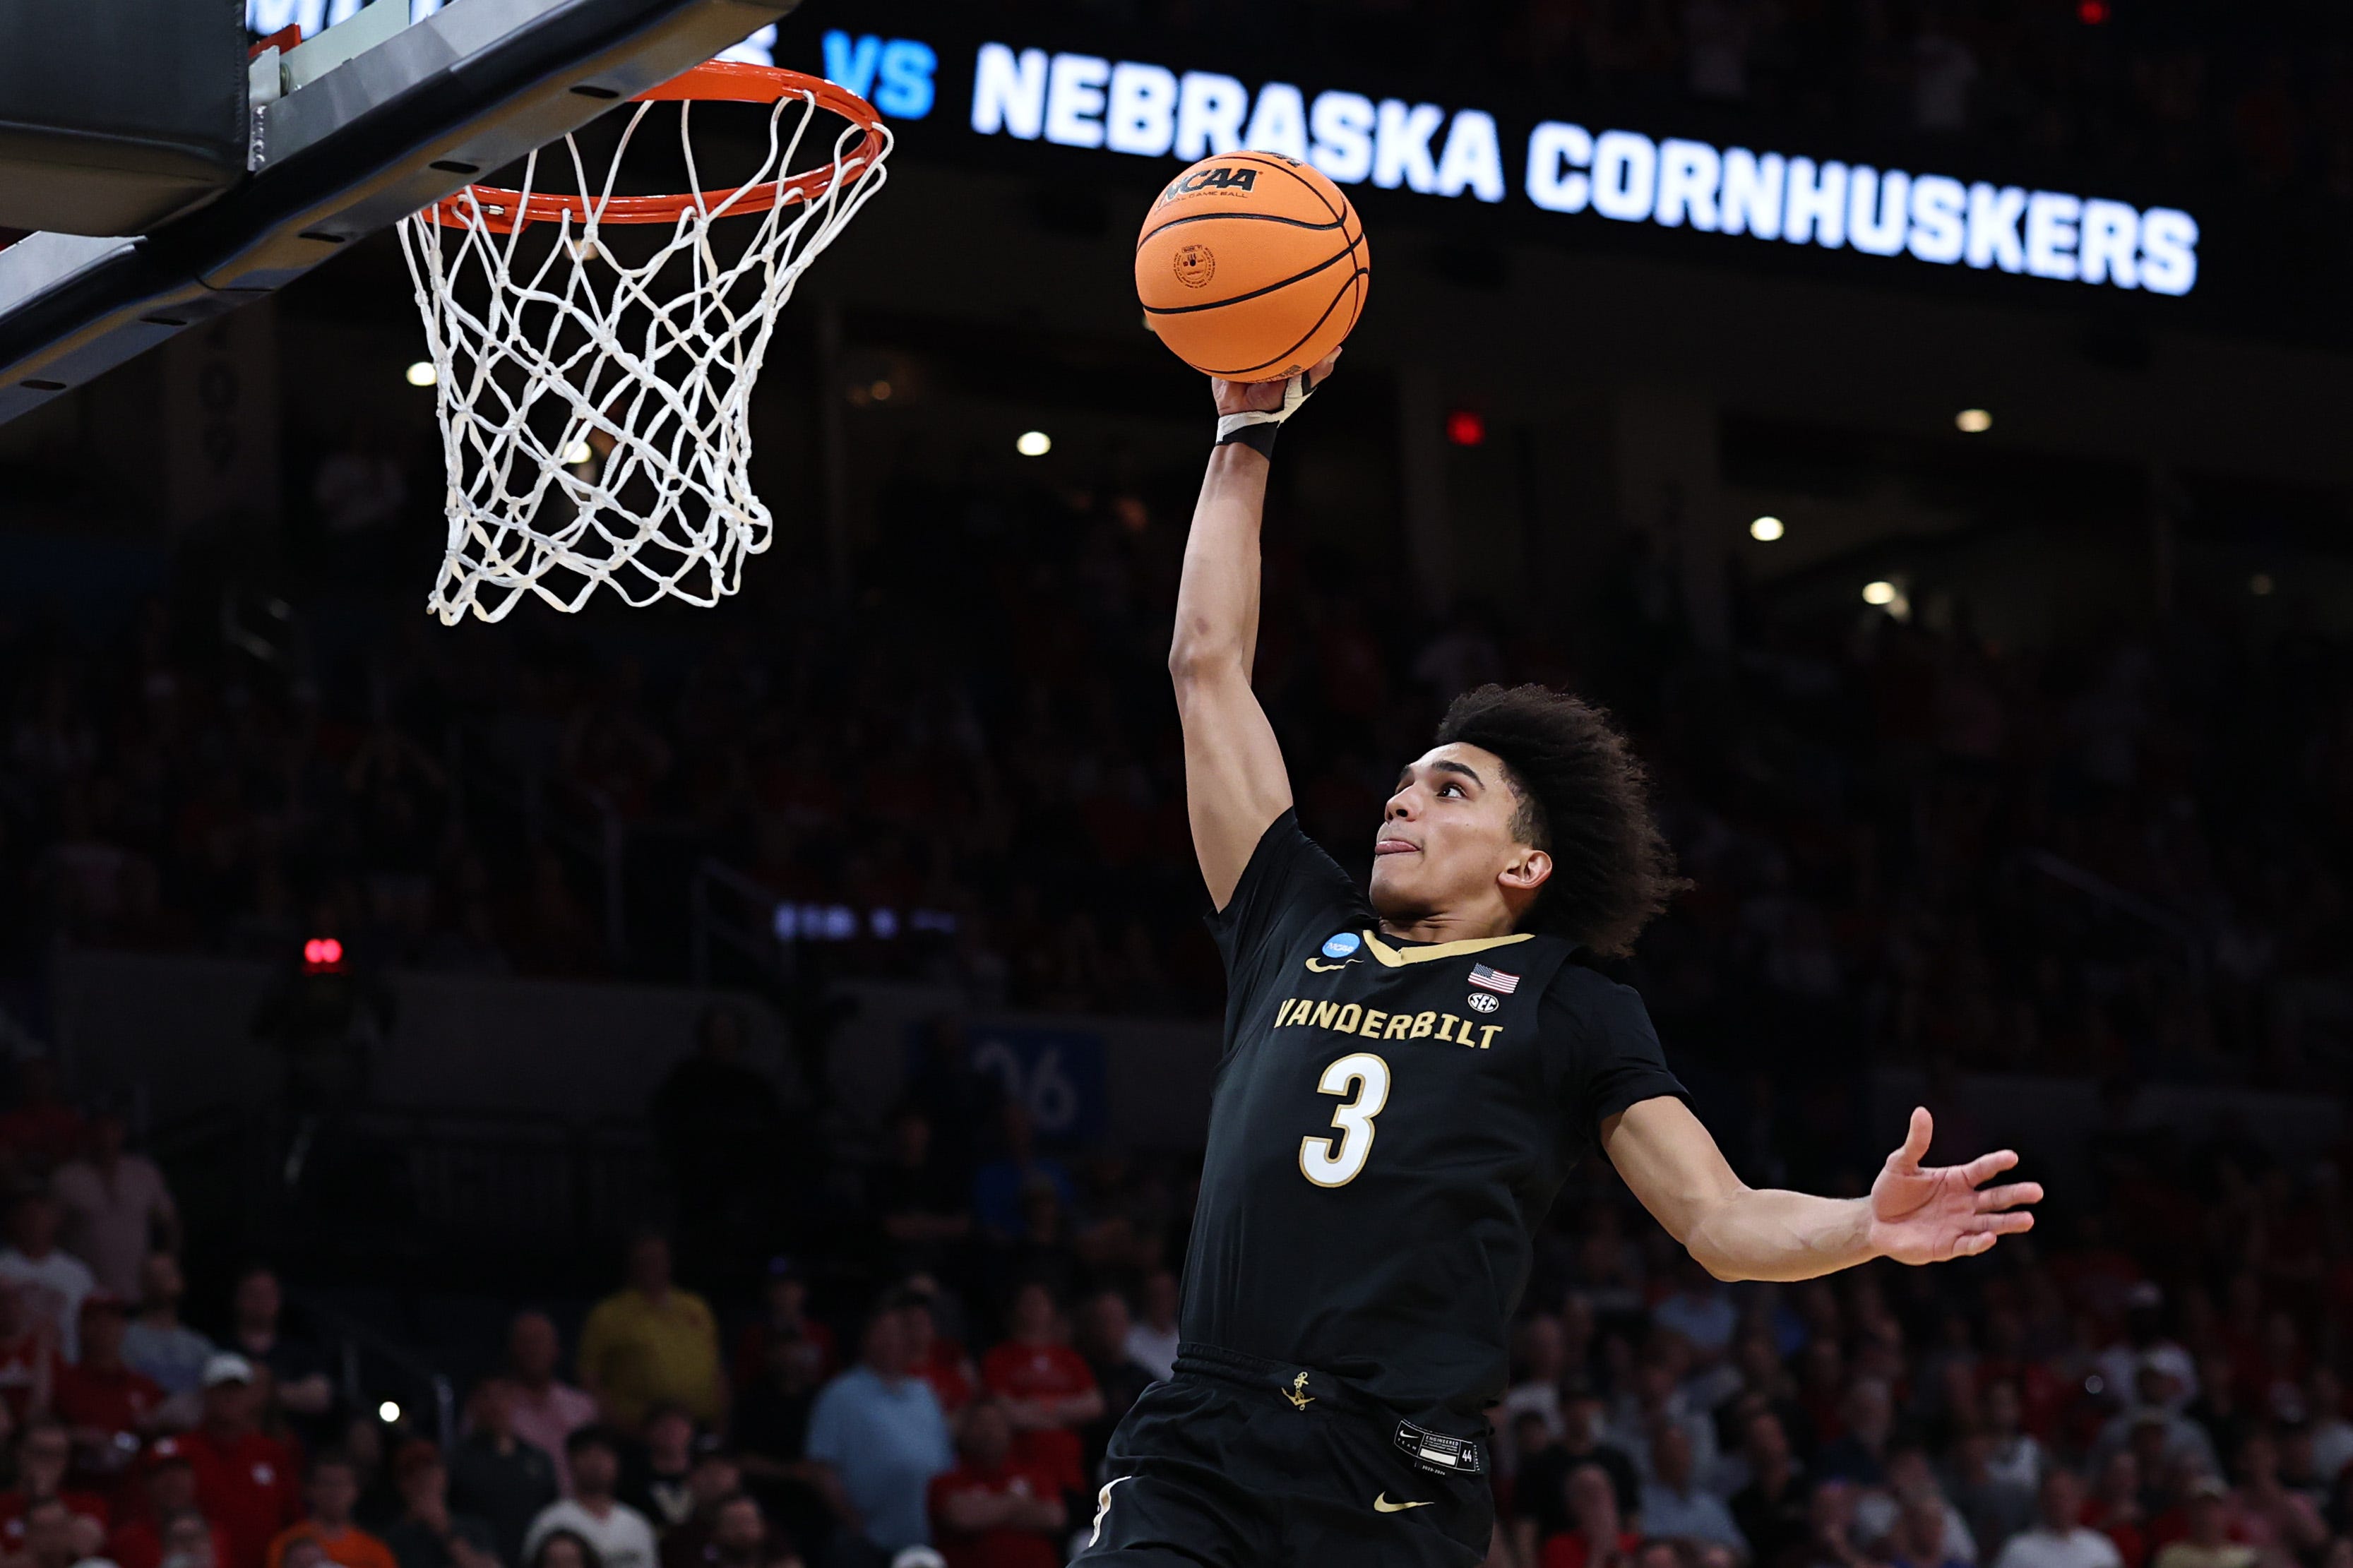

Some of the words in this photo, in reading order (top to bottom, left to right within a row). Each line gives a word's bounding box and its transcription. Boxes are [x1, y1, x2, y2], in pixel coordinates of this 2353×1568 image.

[821, 29, 938, 120] VS
[970, 42, 1505, 203] NEBRASKA
[1525, 121, 2198, 296] CORNHUSKERS
[1155, 167, 1258, 210] NCAA
[1274, 998, 1503, 1049] VANDERBILT
[1470, 994, 1496, 1011] SEC
[1299, 1052, 1391, 1188] 3
[1426, 1435, 1460, 1447] ENGINEERED
[1462, 1449, 1472, 1463] 44
